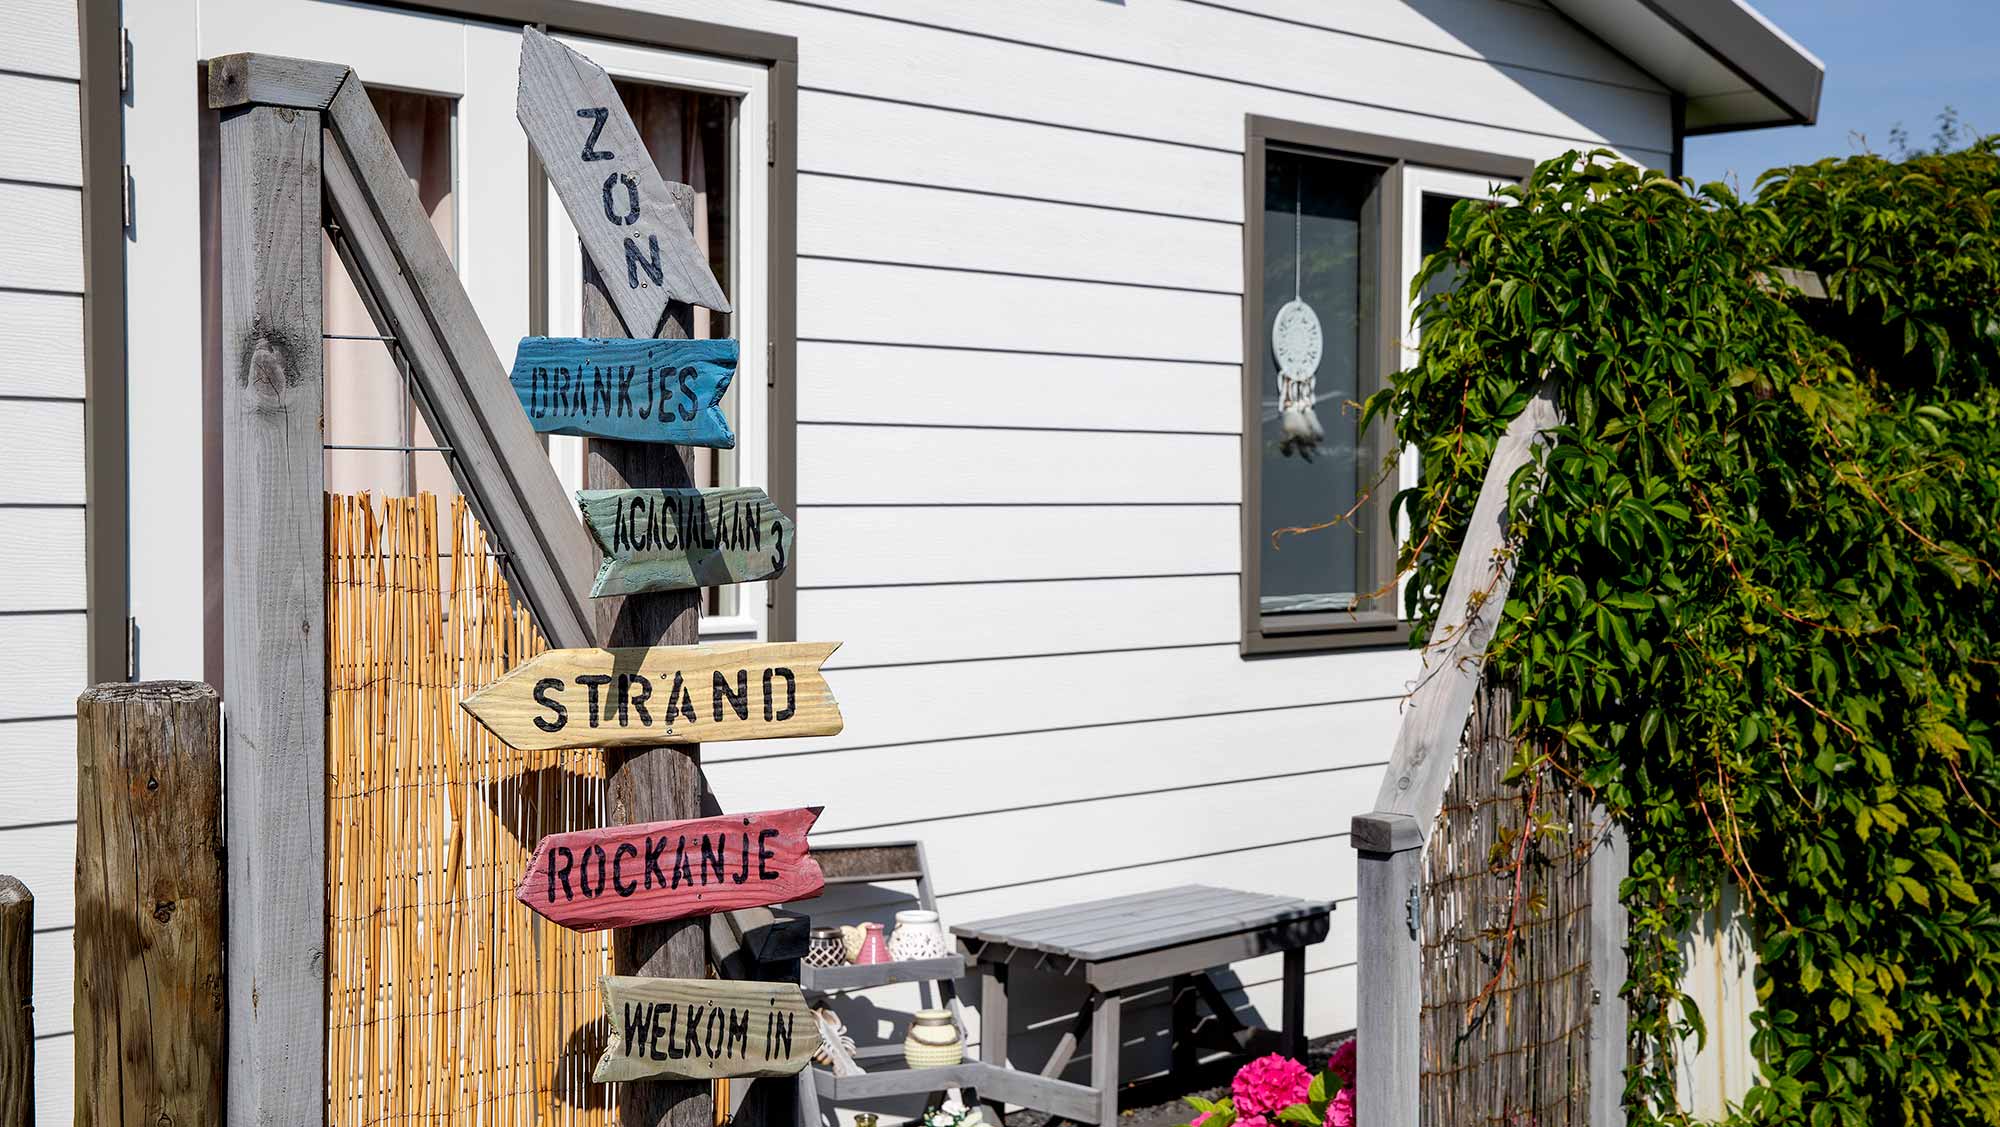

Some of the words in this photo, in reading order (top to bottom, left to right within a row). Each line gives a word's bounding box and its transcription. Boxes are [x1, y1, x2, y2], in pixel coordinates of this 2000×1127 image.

[576, 106, 664, 290] ZON
[529, 351, 699, 424] DRANKJES
[613, 496, 762, 554] ACACIALAAN
[770, 520, 785, 571] 3
[532, 666, 797, 733] STRAND
[547, 818, 780, 904] ROCKANJE
[623, 1001, 750, 1061] WELKOM
[764, 998, 794, 1061] IN
